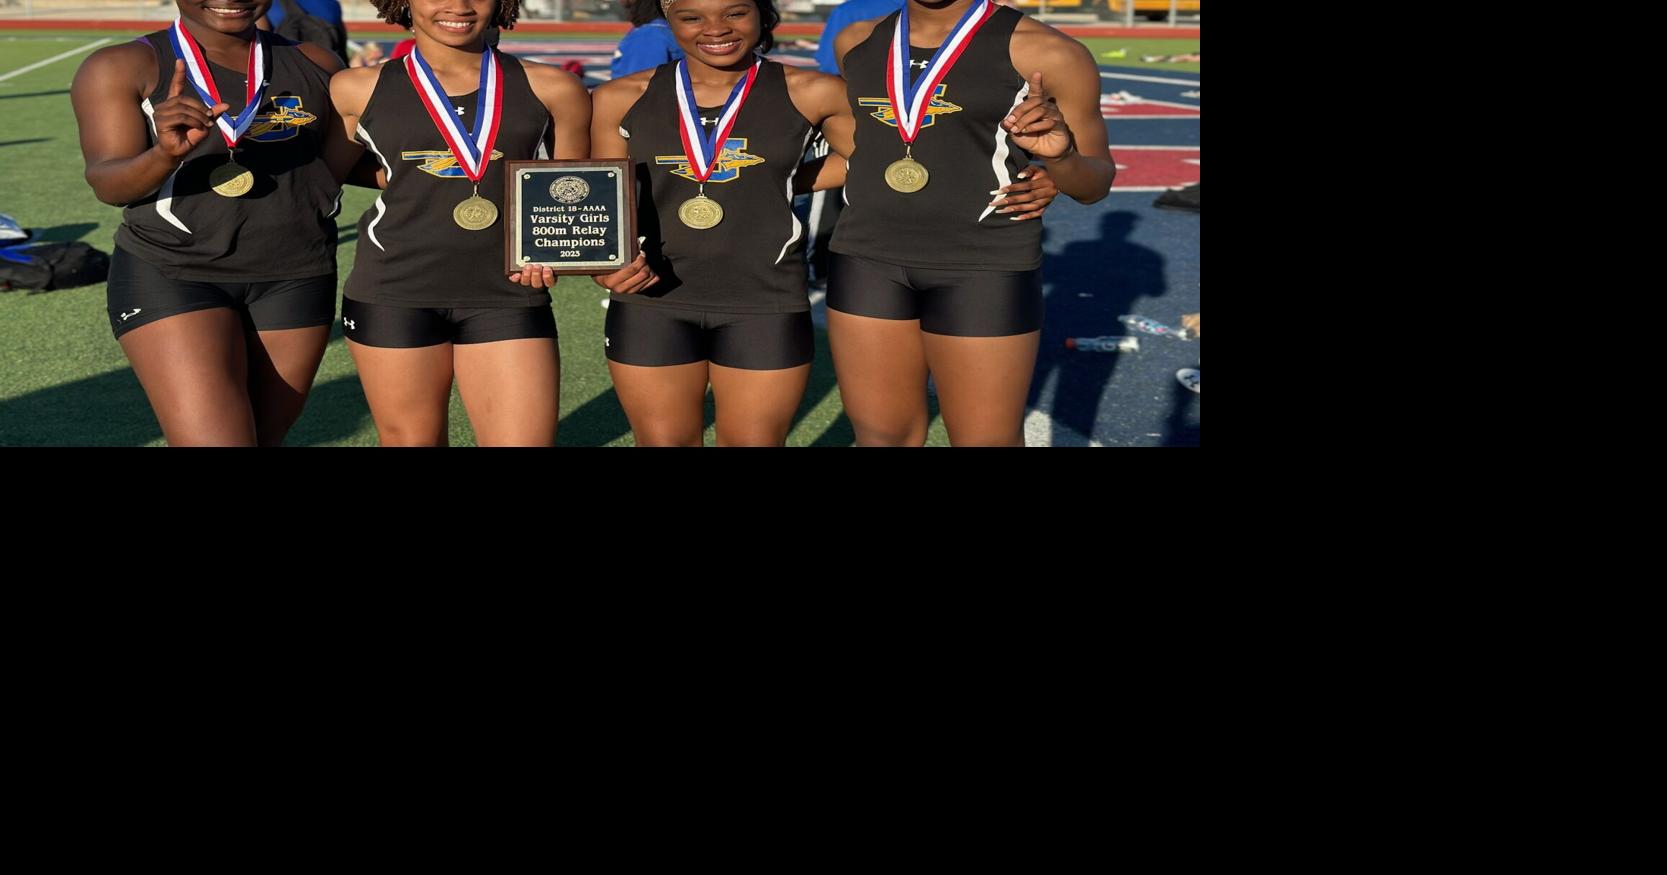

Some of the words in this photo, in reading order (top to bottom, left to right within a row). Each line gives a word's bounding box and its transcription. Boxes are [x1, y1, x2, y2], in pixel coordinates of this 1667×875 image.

[530, 214, 575, 225] Varsity
[580, 213, 610, 223] Girls
[532, 226, 567, 235] 800m
[572, 226, 607, 236] Relay
[535, 237, 605, 248] Champions
